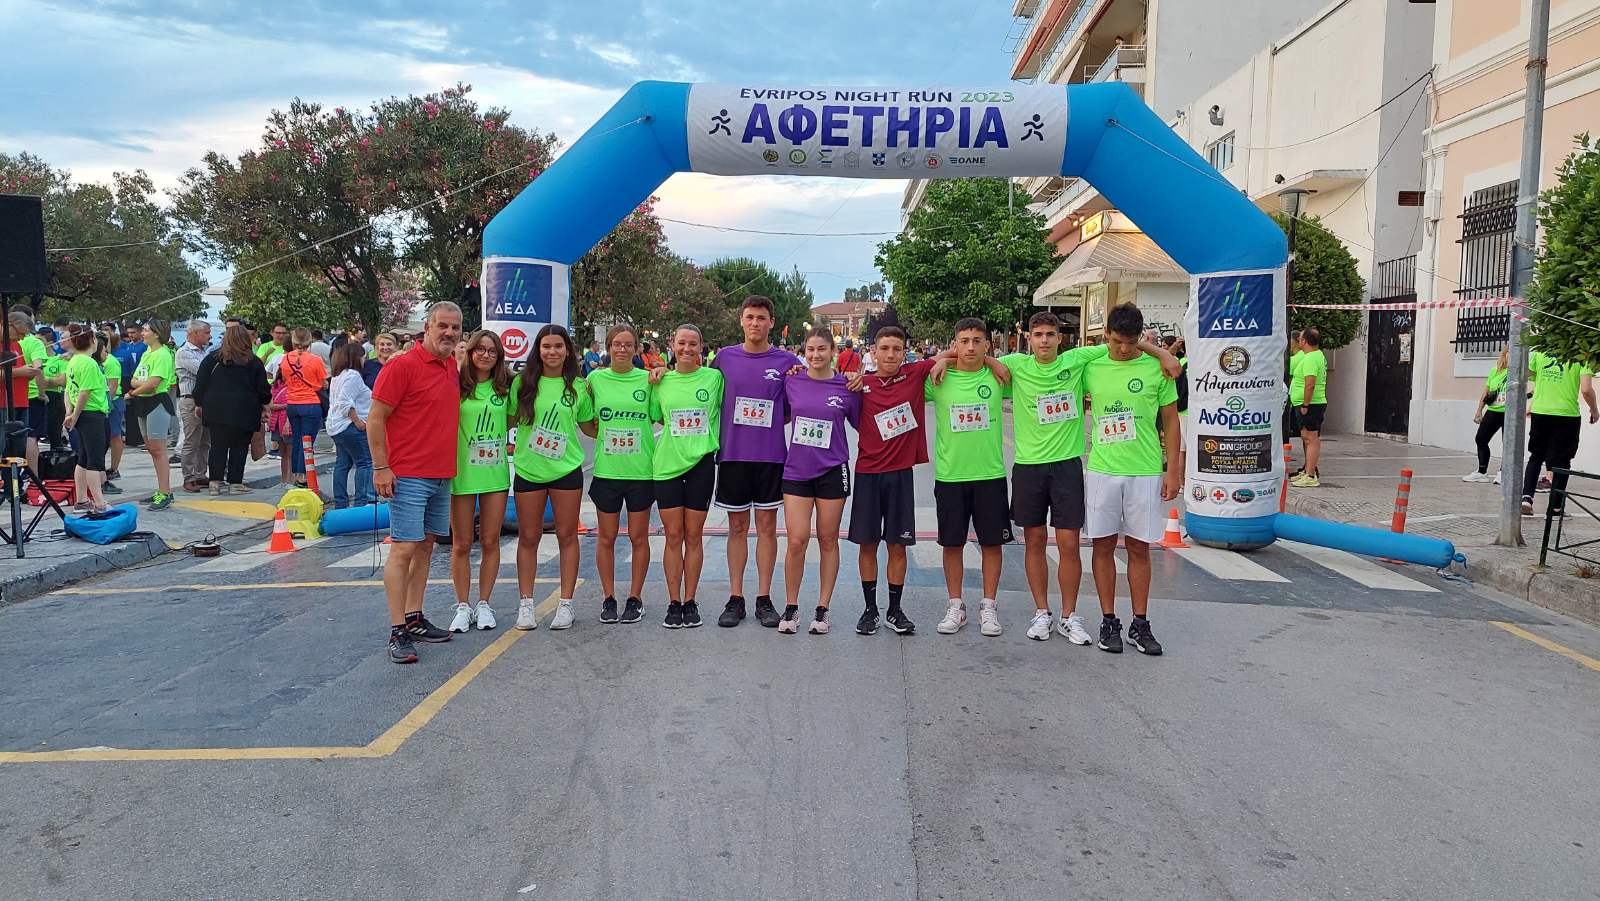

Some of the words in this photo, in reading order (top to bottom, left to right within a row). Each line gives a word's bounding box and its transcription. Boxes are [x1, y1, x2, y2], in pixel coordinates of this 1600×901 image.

[740, 88, 827, 100] EVRIPOS
[835, 91, 901, 102] NIGHT
[908, 91, 952, 102] RUN
[960, 91, 1015, 103] 2023
[741, 103, 1009, 149] ΑΦΕΤΗΡΙΑ
[495, 302, 537, 316] ΔΕΔΑ
[1211, 318, 1259, 331] ΔΕΔΑ
[743, 407, 765, 419] 562
[1045, 402, 1069, 415] 860
[679, 417, 701, 428] 829
[886, 414, 908, 430] 616
[958, 412, 982, 423] 954
[1198, 407, 1271, 430] Ανδρέου
[801, 427, 823, 439] 360
[1104, 422, 1127, 435] 615
[536, 436, 559, 451] 862
[612, 437, 634, 447] 955
[479, 448, 499, 458] 861
